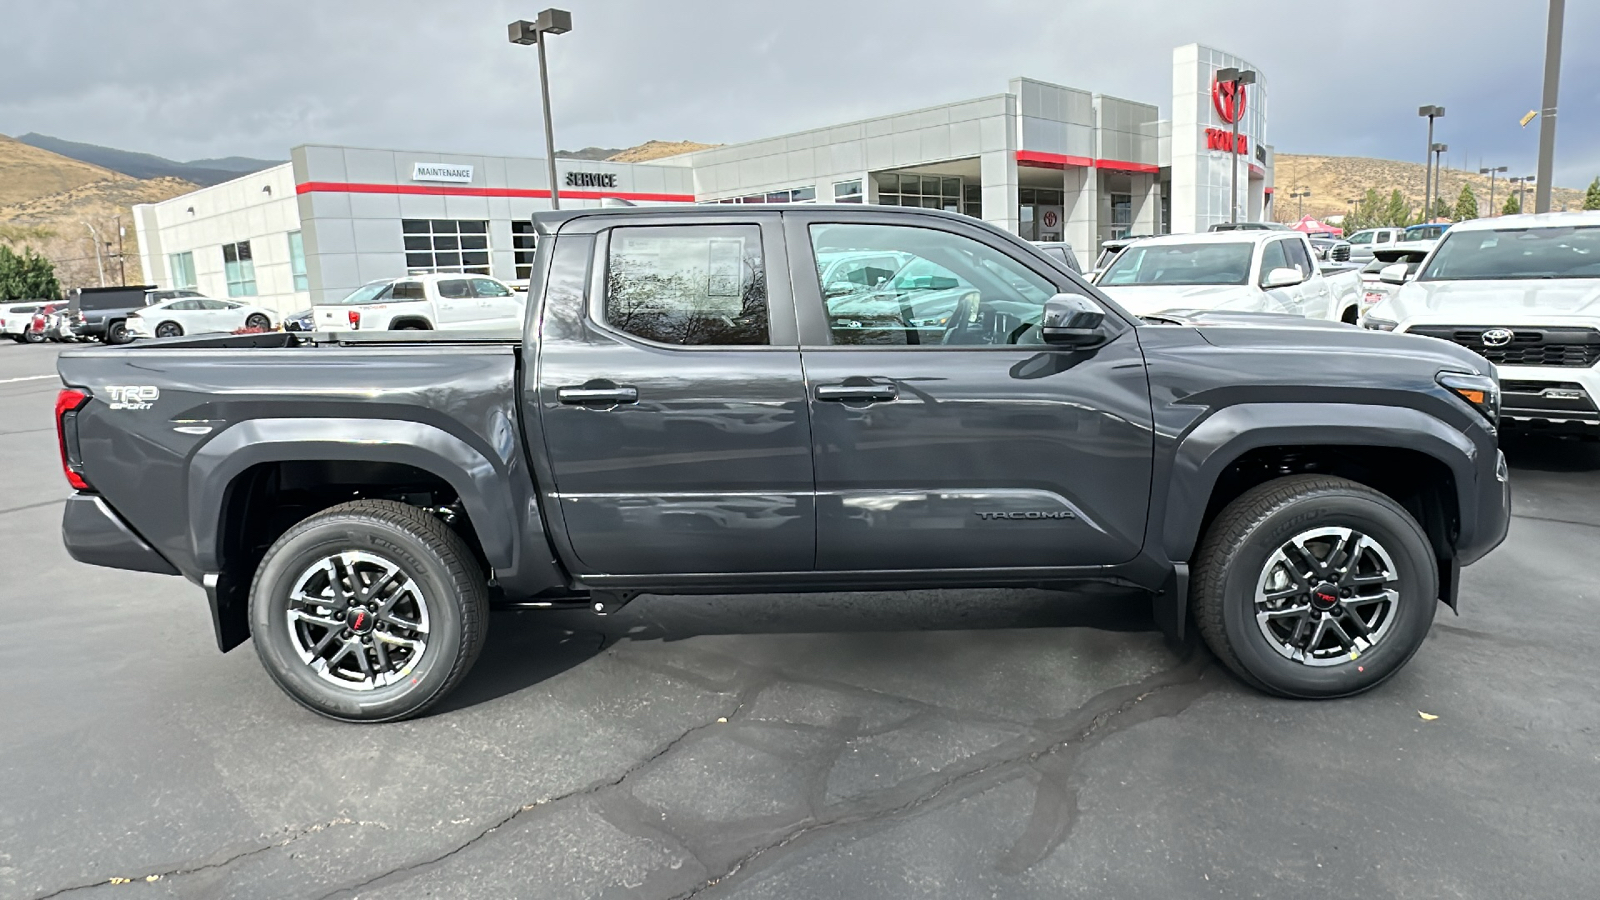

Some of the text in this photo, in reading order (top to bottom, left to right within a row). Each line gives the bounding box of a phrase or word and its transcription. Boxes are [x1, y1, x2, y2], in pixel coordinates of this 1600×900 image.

[1205, 128, 1248, 155] TOYTA
[417, 167, 471, 178] MAINTENANCE
[566, 171, 618, 188] SERVICE
[105, 385, 159, 402] TRD
[975, 511, 1076, 520] TACOMA
[1317, 592, 1336, 602] TRD
